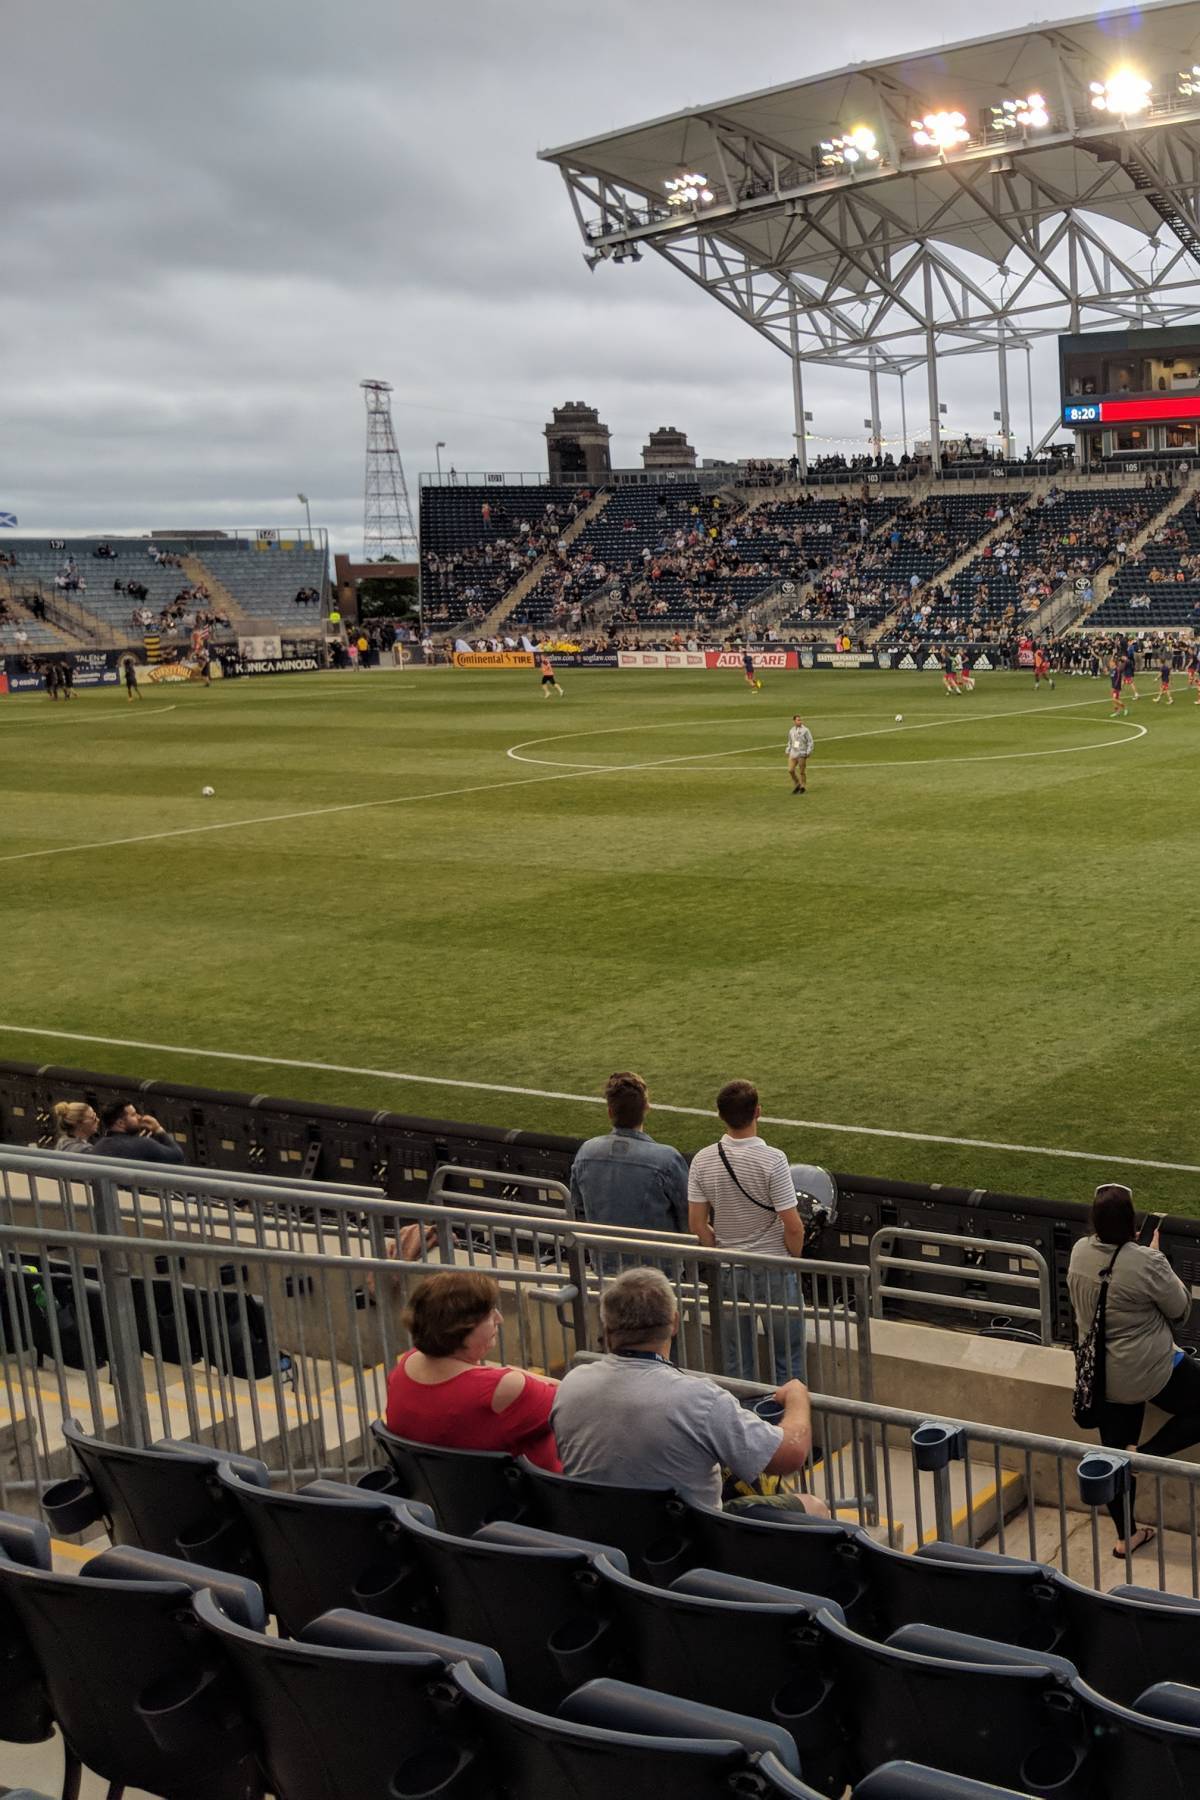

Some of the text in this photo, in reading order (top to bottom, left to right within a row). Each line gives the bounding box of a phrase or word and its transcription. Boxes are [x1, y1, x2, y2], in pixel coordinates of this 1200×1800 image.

[1070, 408, 1096, 420] 8:20
[1125, 464, 1138, 472] 105
[235, 659, 319, 673] KNICA MINOLTA
[457, 653, 532, 666] Continental TIRE
[718, 653, 786, 666] ADVCARE
